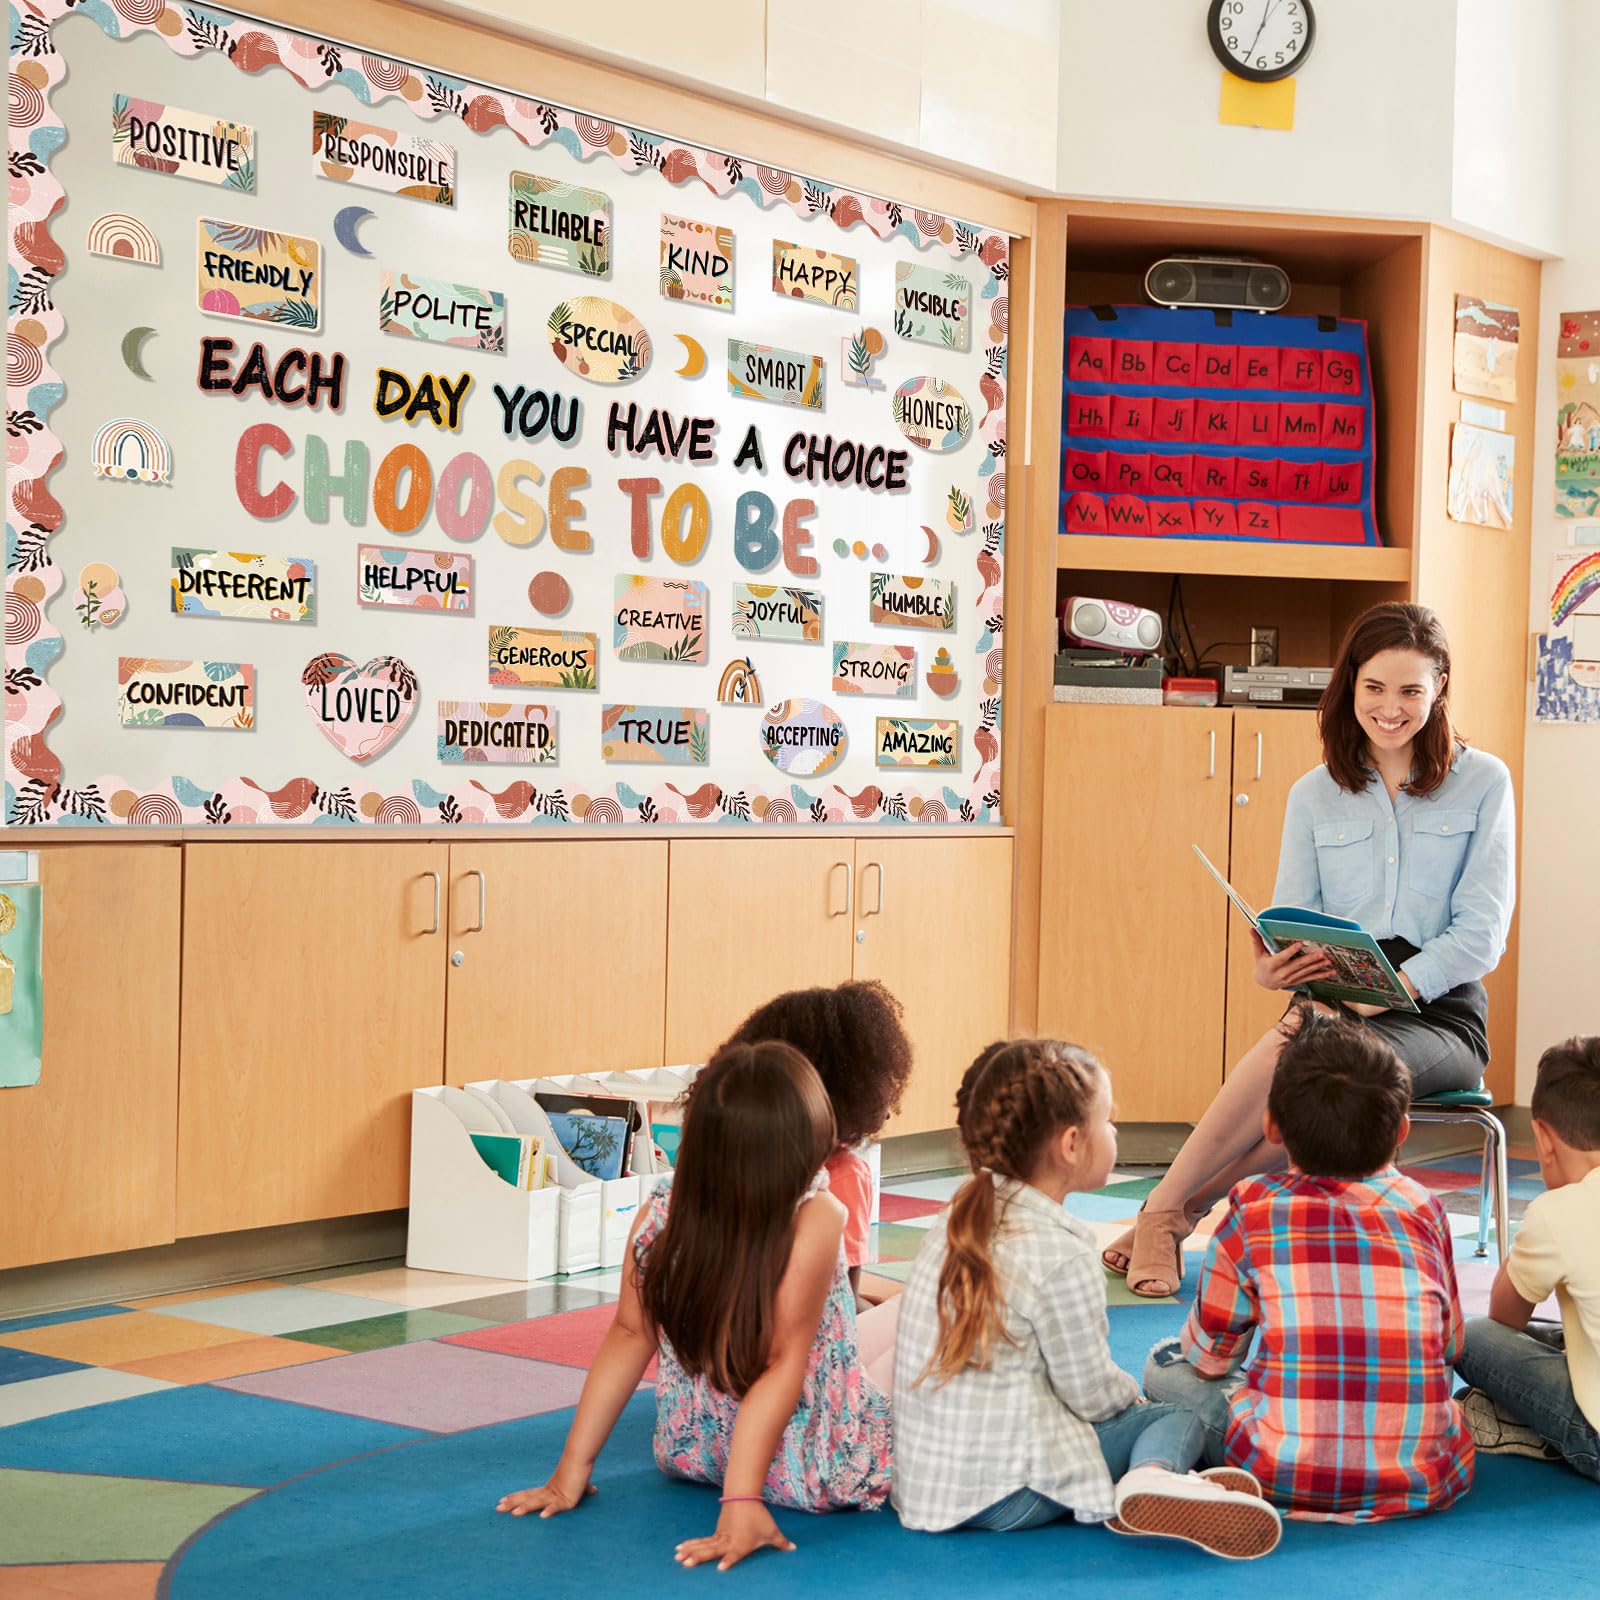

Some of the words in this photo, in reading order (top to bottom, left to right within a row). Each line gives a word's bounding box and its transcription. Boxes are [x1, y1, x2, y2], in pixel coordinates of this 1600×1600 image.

[1226, 2, 1244, 14] 10
[1288, 3, 1298, 15] 2
[1221, 17, 1232, 30] 9
[1291, 21, 1303, 34] 3
[1226, 36, 1238, 50] 8
[1286, 39, 1297, 52] 4
[1241, 51, 1252, 64] 7
[1256, 56, 1267, 69] 6
[1274, 52, 1285, 64] 5
[128, 116, 241, 172] POSITIVE
[323, 133, 449, 188] RESPONSIBLE
[514, 199, 605, 247] RELIABLE
[203, 251, 316, 298] FRIENDLY
[667, 242, 729, 279] KIND
[779, 257, 852, 295] HAPPY
[393, 291, 494, 331] POLITE
[903, 287, 961, 322] VISIBLE
[559, 321, 638, 359] SPECIAL
[744, 355, 807, 394] SMART
[1078, 351, 1103, 369] Aa
[1121, 353, 1145, 372] Bb
[1166, 355, 1191, 374] Cc
[1206, 357, 1231, 376] Dd
[1247, 360, 1268, 377] Ee
[1296, 361, 1313, 379] Ff
[1327, 360, 1353, 385] Gg
[199, 337, 347, 411] EACH
[375, 368, 472, 430] DAY
[493, 383, 580, 442] YOU
[607, 402, 715, 462] HAVE
[734, 424, 763, 469] A
[783, 431, 909, 490] CHOICE
[903, 395, 964, 432] HONEST
[1078, 408, 1102, 426] Hh
[1126, 410, 1139, 426] Ii
[1168, 409, 1184, 431] Jj
[1207, 413, 1227, 430] Kk
[1252, 416, 1267, 432] Ll
[1285, 416, 1317, 433] Mm
[1333, 418, 1356, 436] Nn
[1072, 463, 1100, 481] Oo
[1119, 464, 1141, 487] Pp
[1154, 465, 1183, 487] Qq
[1207, 468, 1225, 485] Rr
[1248, 470, 1268, 488] Ss
[1294, 473, 1310, 489] Tt
[1329, 475, 1349, 492] Uu
[235, 422, 592, 551] CHOOSE
[617, 477, 712, 563] TO
[1076, 505, 1097, 522] Vv
[1111, 506, 1144, 524] Ww
[1158, 512, 1182, 526] Xx
[1203, 507, 1224, 527] Yy
[1248, 512, 1270, 528] Zz
[178, 567, 312, 604] DIFFERENT
[364, 564, 467, 595] HELPFUL
[745, 599, 808, 627] JOYFUL
[881, 592, 943, 617] HUMBLE
[617, 609, 703, 631] CREATIVE
[497, 646, 589, 670] GENEROUS
[839, 659, 910, 681] STRONG
[126, 680, 249, 708] CONFIDENT
[321, 686, 400, 723] LOVED
[445, 719, 550, 749] DEDICATED
[617, 719, 692, 745] TRUE
[766, 726, 840, 747] ACCEPTING
[881, 733, 954, 754] AMAZING
